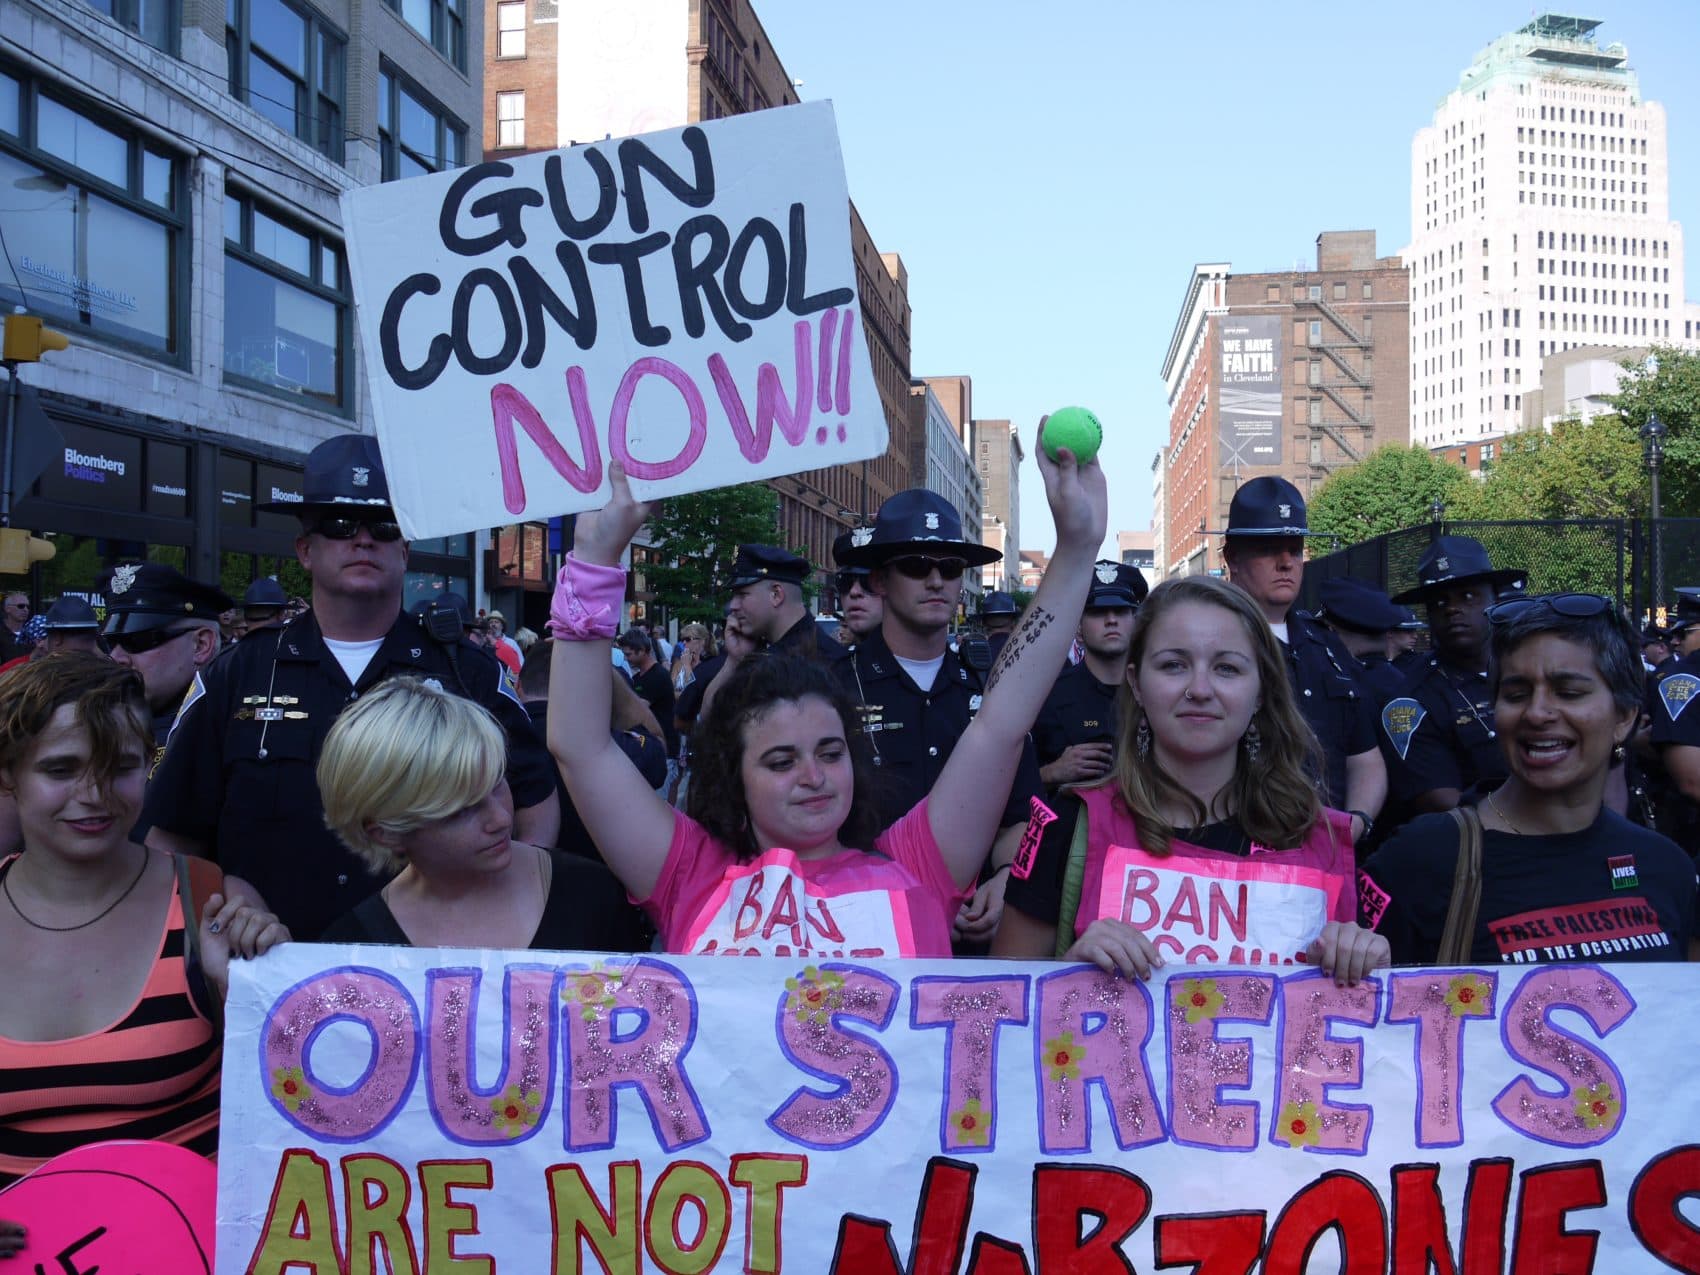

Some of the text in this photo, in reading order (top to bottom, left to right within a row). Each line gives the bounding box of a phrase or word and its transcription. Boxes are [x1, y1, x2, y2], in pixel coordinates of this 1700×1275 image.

[439, 127, 715, 256] GUN
[380, 203, 855, 390] CONTROL
[1223, 339, 1273, 352] WE HAVE
[1223, 374, 1273, 382] in Cleveland
[65, 448, 125, 476] Bloomberg
[65, 464, 105, 482] Politics
[1612, 866, 1636, 879] LIVES
[733, 870, 845, 949] BAN
[1121, 869, 1248, 942] BAN
[1495, 921, 1556, 944] FREE
[1544, 943, 1576, 960] THE
[1582, 932, 1669, 957] OCCUPATION
[259, 957, 1638, 1156] OUR STREETS
[246, 1148, 496, 1275] ARE
[544, 1154, 808, 1275] NOT
